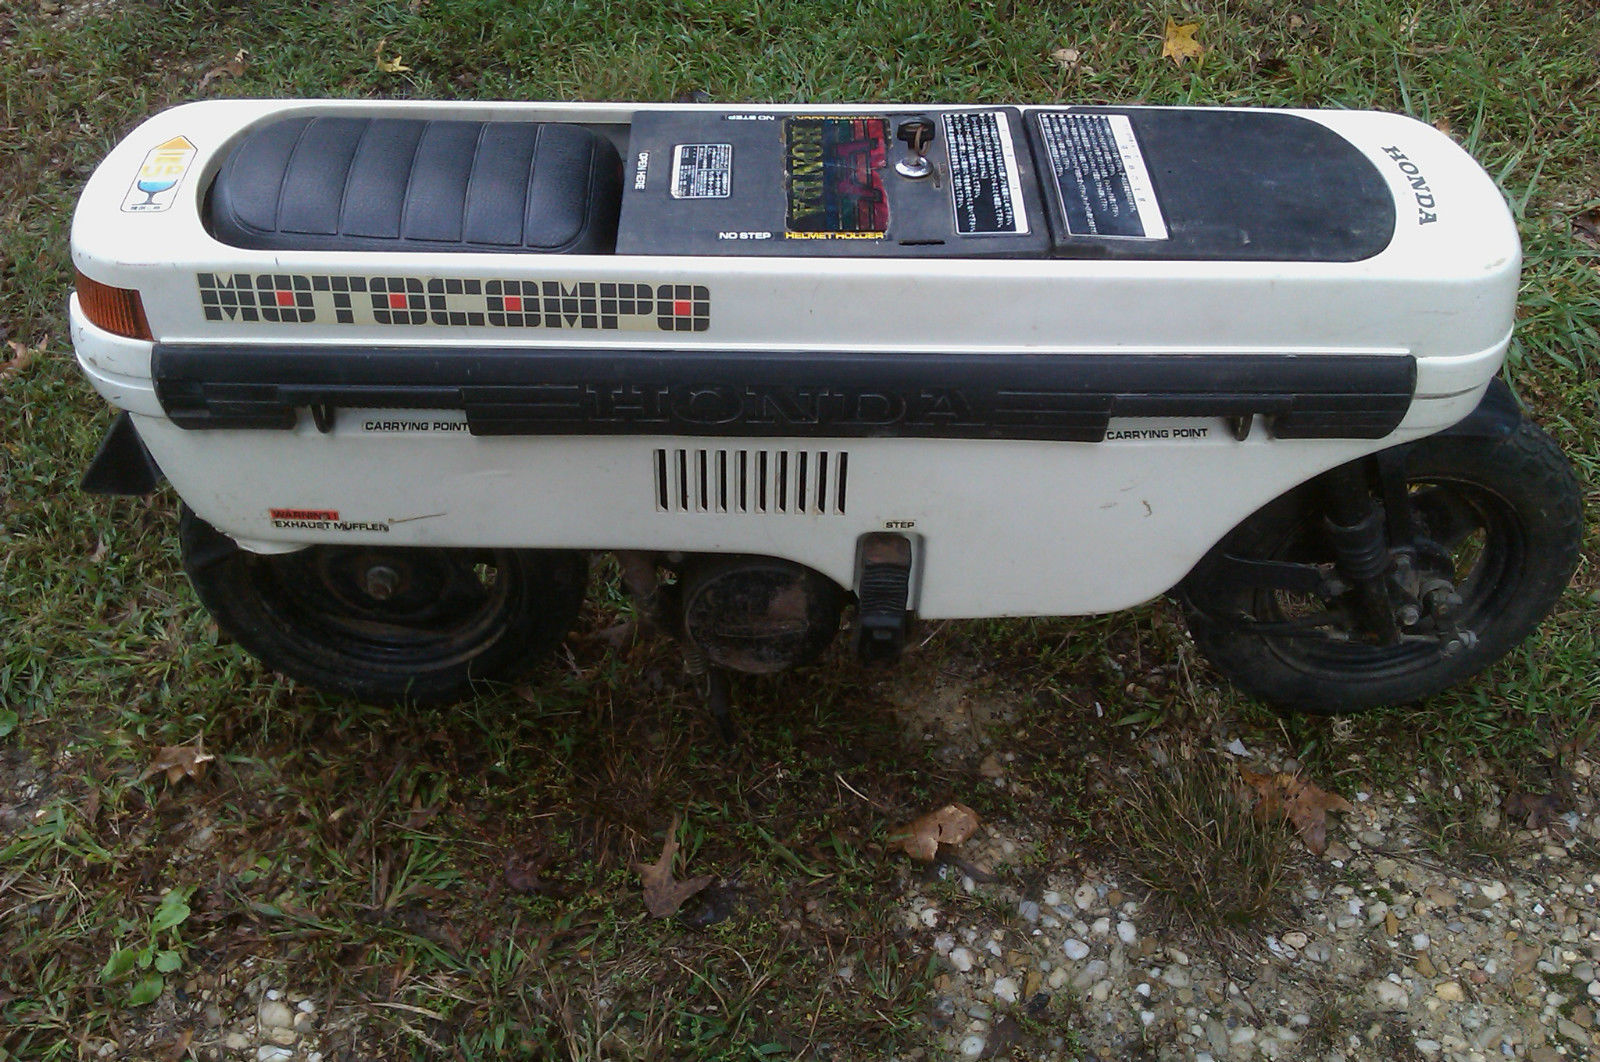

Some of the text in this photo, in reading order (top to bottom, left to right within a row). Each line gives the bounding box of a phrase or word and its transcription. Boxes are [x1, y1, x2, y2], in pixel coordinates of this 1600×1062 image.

[792, 126, 825, 220] HONDA
[1381, 146, 1437, 225] HONDA
[719, 231, 772, 240] NO STEP
[785, 231, 884, 240] HELMET HOLDER
[197, 273, 710, 331] MOTOCOMPO
[586, 385, 986, 427] HONDA
[365, 421, 468, 431] CARRYING POINT
[1106, 428, 1208, 440] CARRYING POINT
[275, 520, 331, 529] EXHAUST
[886, 521, 915, 529] STEP
